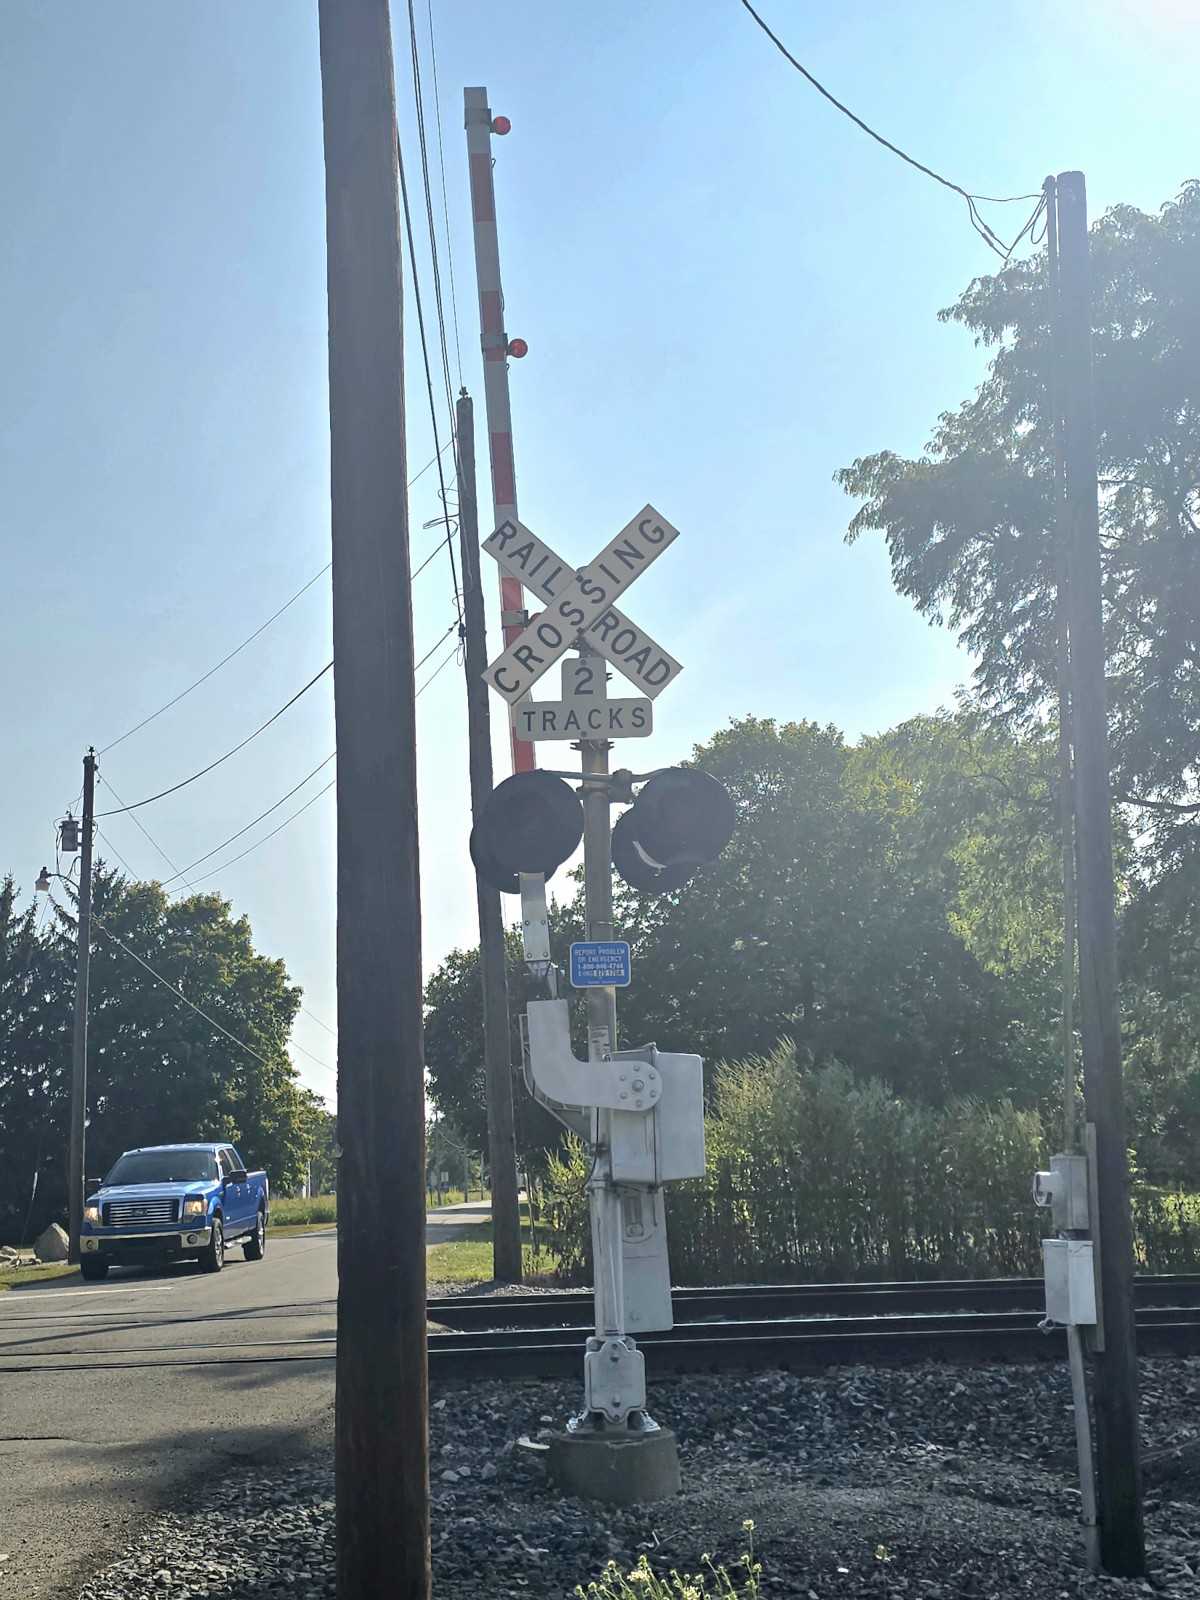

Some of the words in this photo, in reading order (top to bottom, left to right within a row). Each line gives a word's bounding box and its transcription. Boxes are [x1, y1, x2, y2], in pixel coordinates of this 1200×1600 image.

[489, 520, 562, 597] RAIL
[591, 610, 671, 686] ROAD
[494, 519, 665, 693] CROSSING
[523, 707, 645, 731] TRACKS
[574, 667, 594, 695] 2
